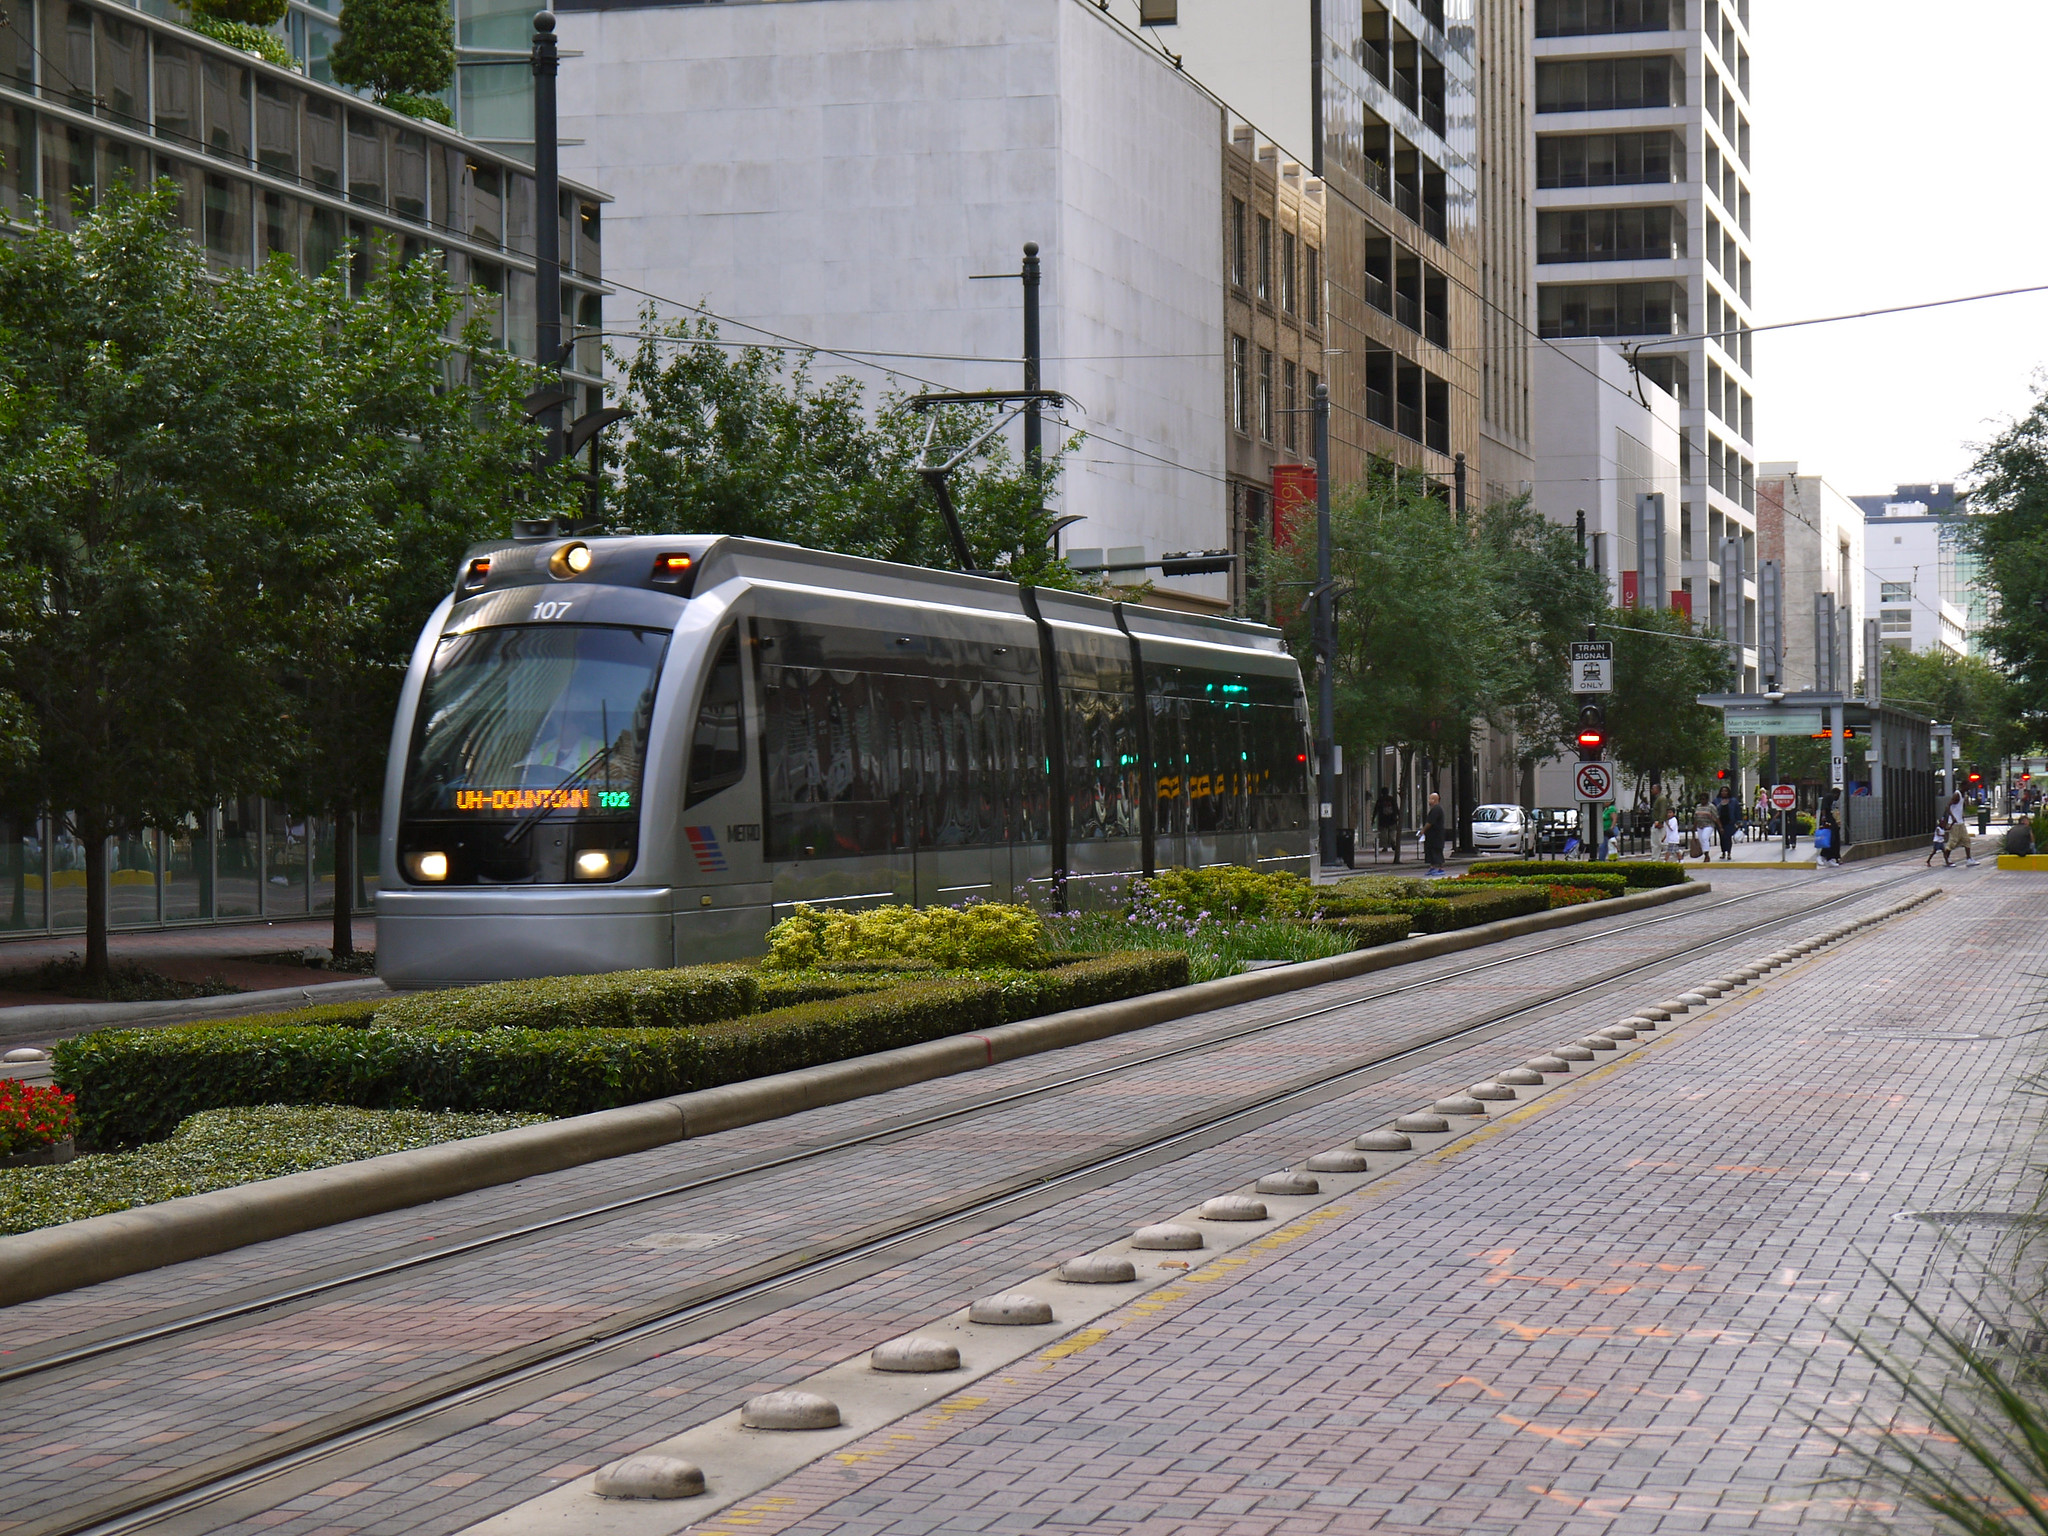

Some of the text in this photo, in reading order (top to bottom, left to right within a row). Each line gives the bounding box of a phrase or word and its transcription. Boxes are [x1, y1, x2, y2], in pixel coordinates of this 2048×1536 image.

[533, 601, 573, 620] 107
[1575, 652, 1608, 660] SIGNAL
[456, 789, 630, 809] UH-DOWNTOWN 702
[727, 824, 761, 843] METRO
